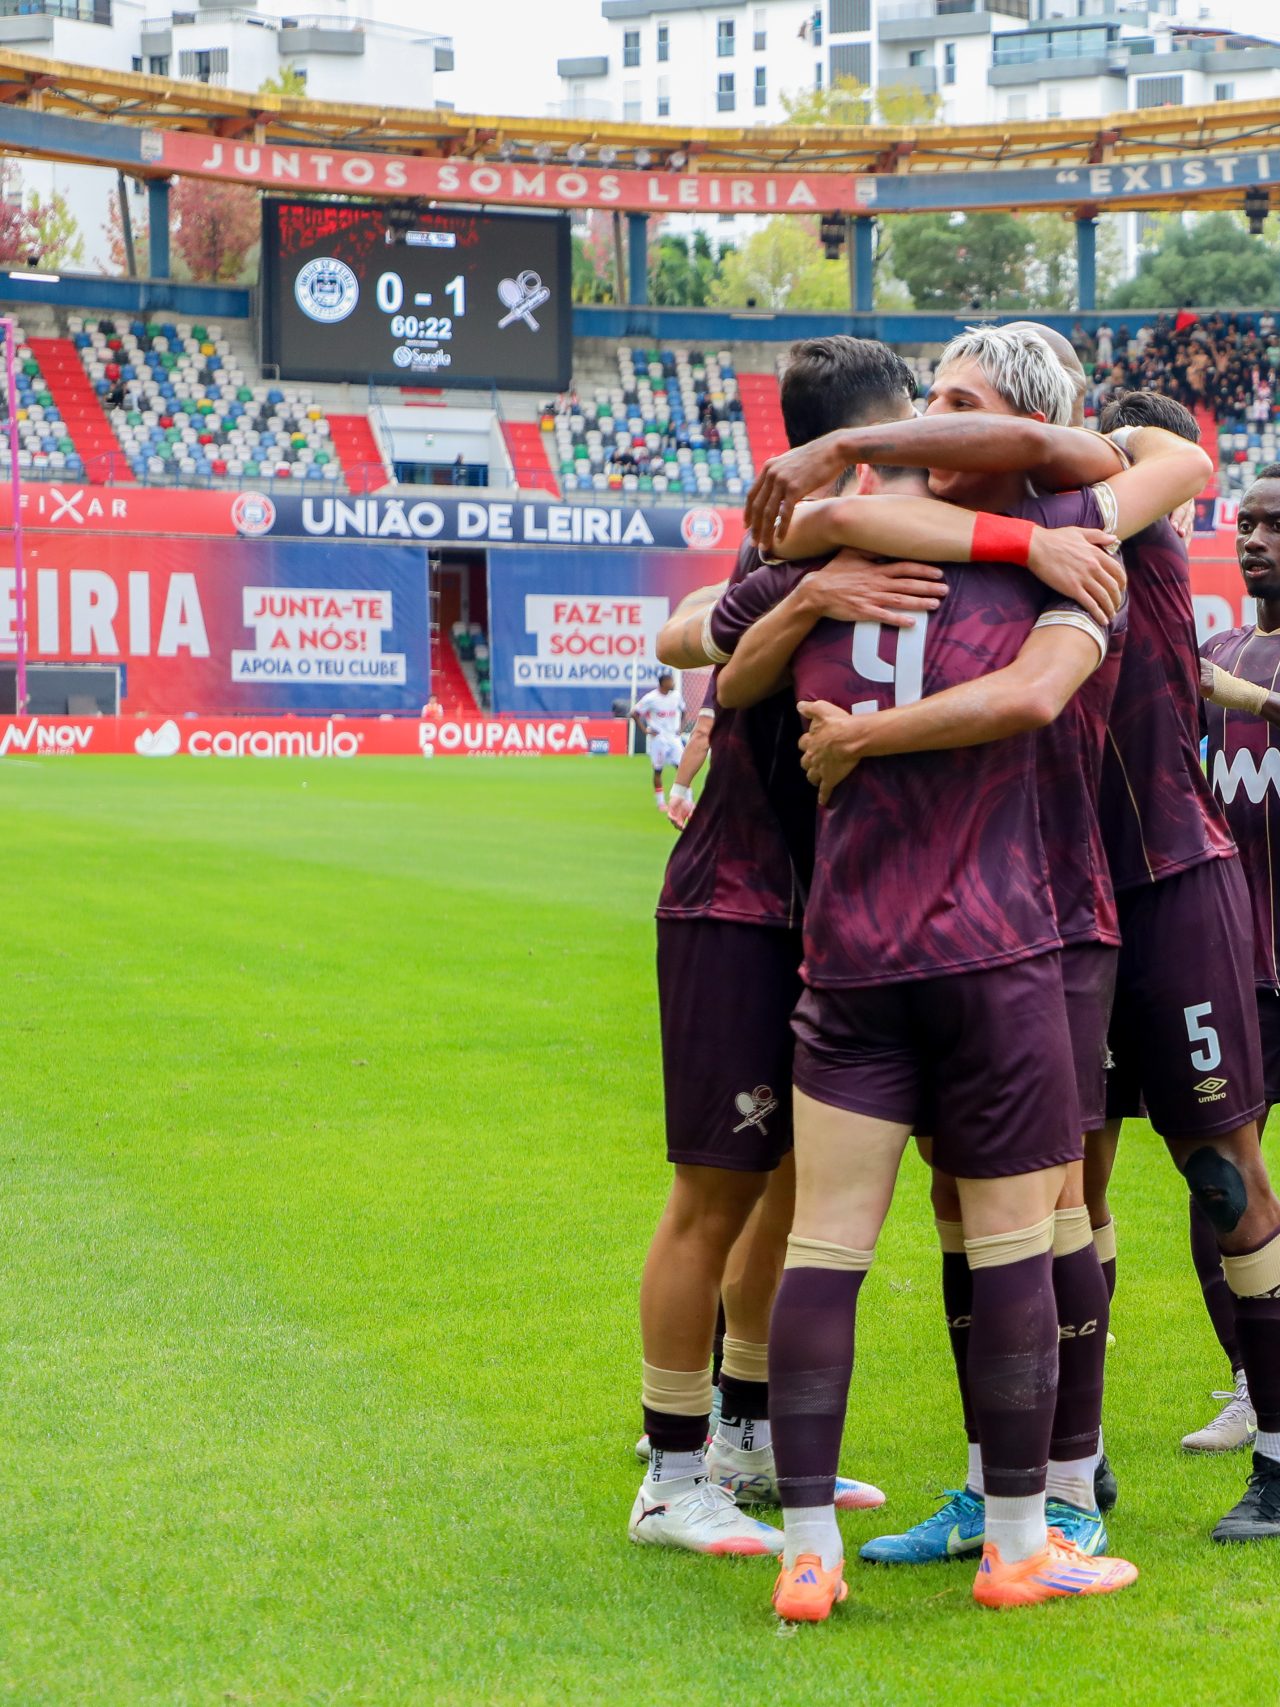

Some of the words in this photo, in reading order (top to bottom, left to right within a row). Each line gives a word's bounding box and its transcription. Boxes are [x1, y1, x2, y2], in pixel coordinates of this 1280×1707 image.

[202, 143, 408, 188] JUNTOS
[437, 164, 621, 200] SOMOS
[649, 177, 818, 207] LEIRIA
[376, 271, 404, 314] 0
[444, 275, 466, 317] 1
[391, 314, 453, 340] 60:22
[302, 497, 445, 539] UNIÃO
[457, 502, 514, 540] DE
[523, 504, 656, 545] LEIRIA
[254, 594, 384, 620] JUNTA-TE
[553, 603, 643, 626] FAZ-TE
[270, 627, 291, 650] A
[298, 621, 368, 652] NÓS!
[549, 628, 647, 657] SÓCIO!
[240, 657, 293, 675] APOIA
[297, 658, 312, 675] O
[316, 658, 345, 676] TEU
[348, 660, 399, 677] CLUBE
[517, 664, 532, 680] O
[535, 663, 565, 680] TEU
[567, 663, 621, 681] APOIO
[37, 725, 94, 748] NOV
[188, 720, 360, 758] caramulo
[418, 722, 589, 752] POUPANÇA
[1183, 1000, 1222, 1072] 5
[1197, 1091, 1227, 1104] umbro
